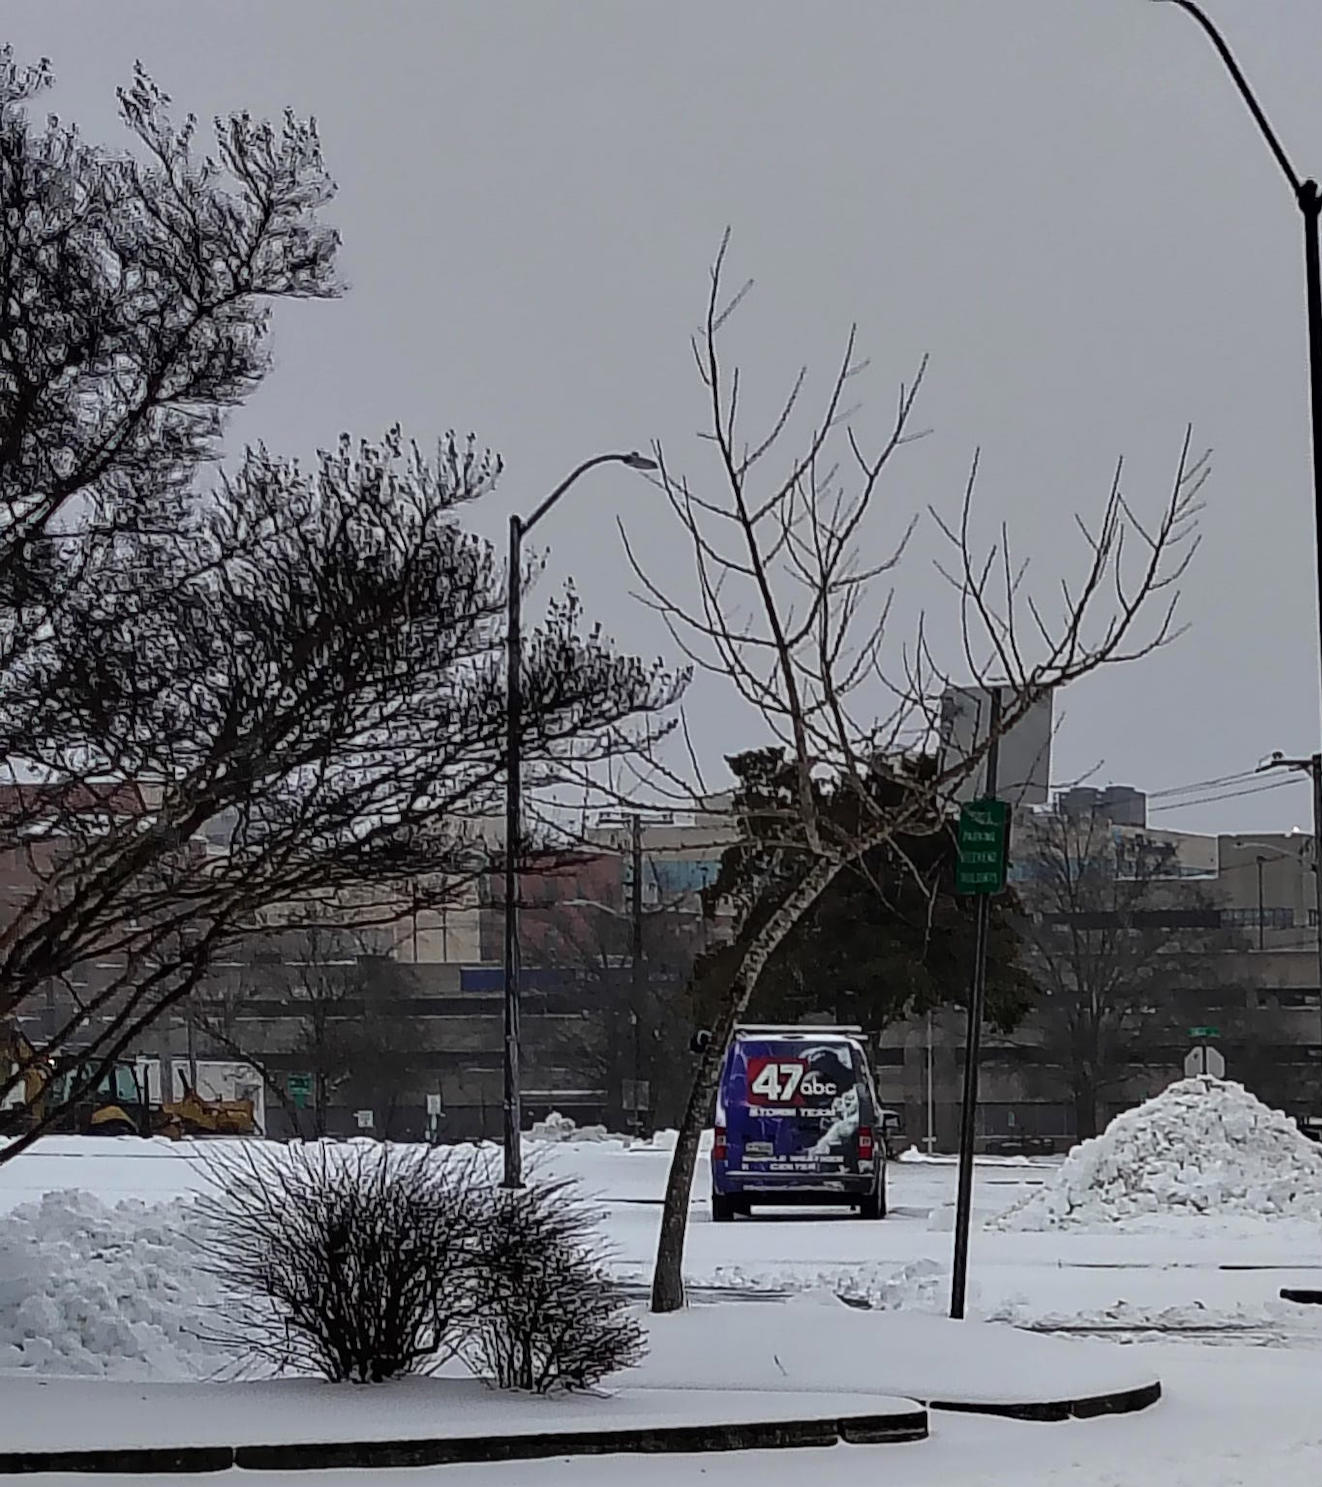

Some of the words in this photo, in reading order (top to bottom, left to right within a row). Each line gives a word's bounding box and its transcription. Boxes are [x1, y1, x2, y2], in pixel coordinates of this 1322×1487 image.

[751, 1063, 804, 1101] 47
[800, 1075, 837, 1096] abc
[749, 1107, 797, 1117] STORM
[800, 1107, 836, 1117] TEAM
